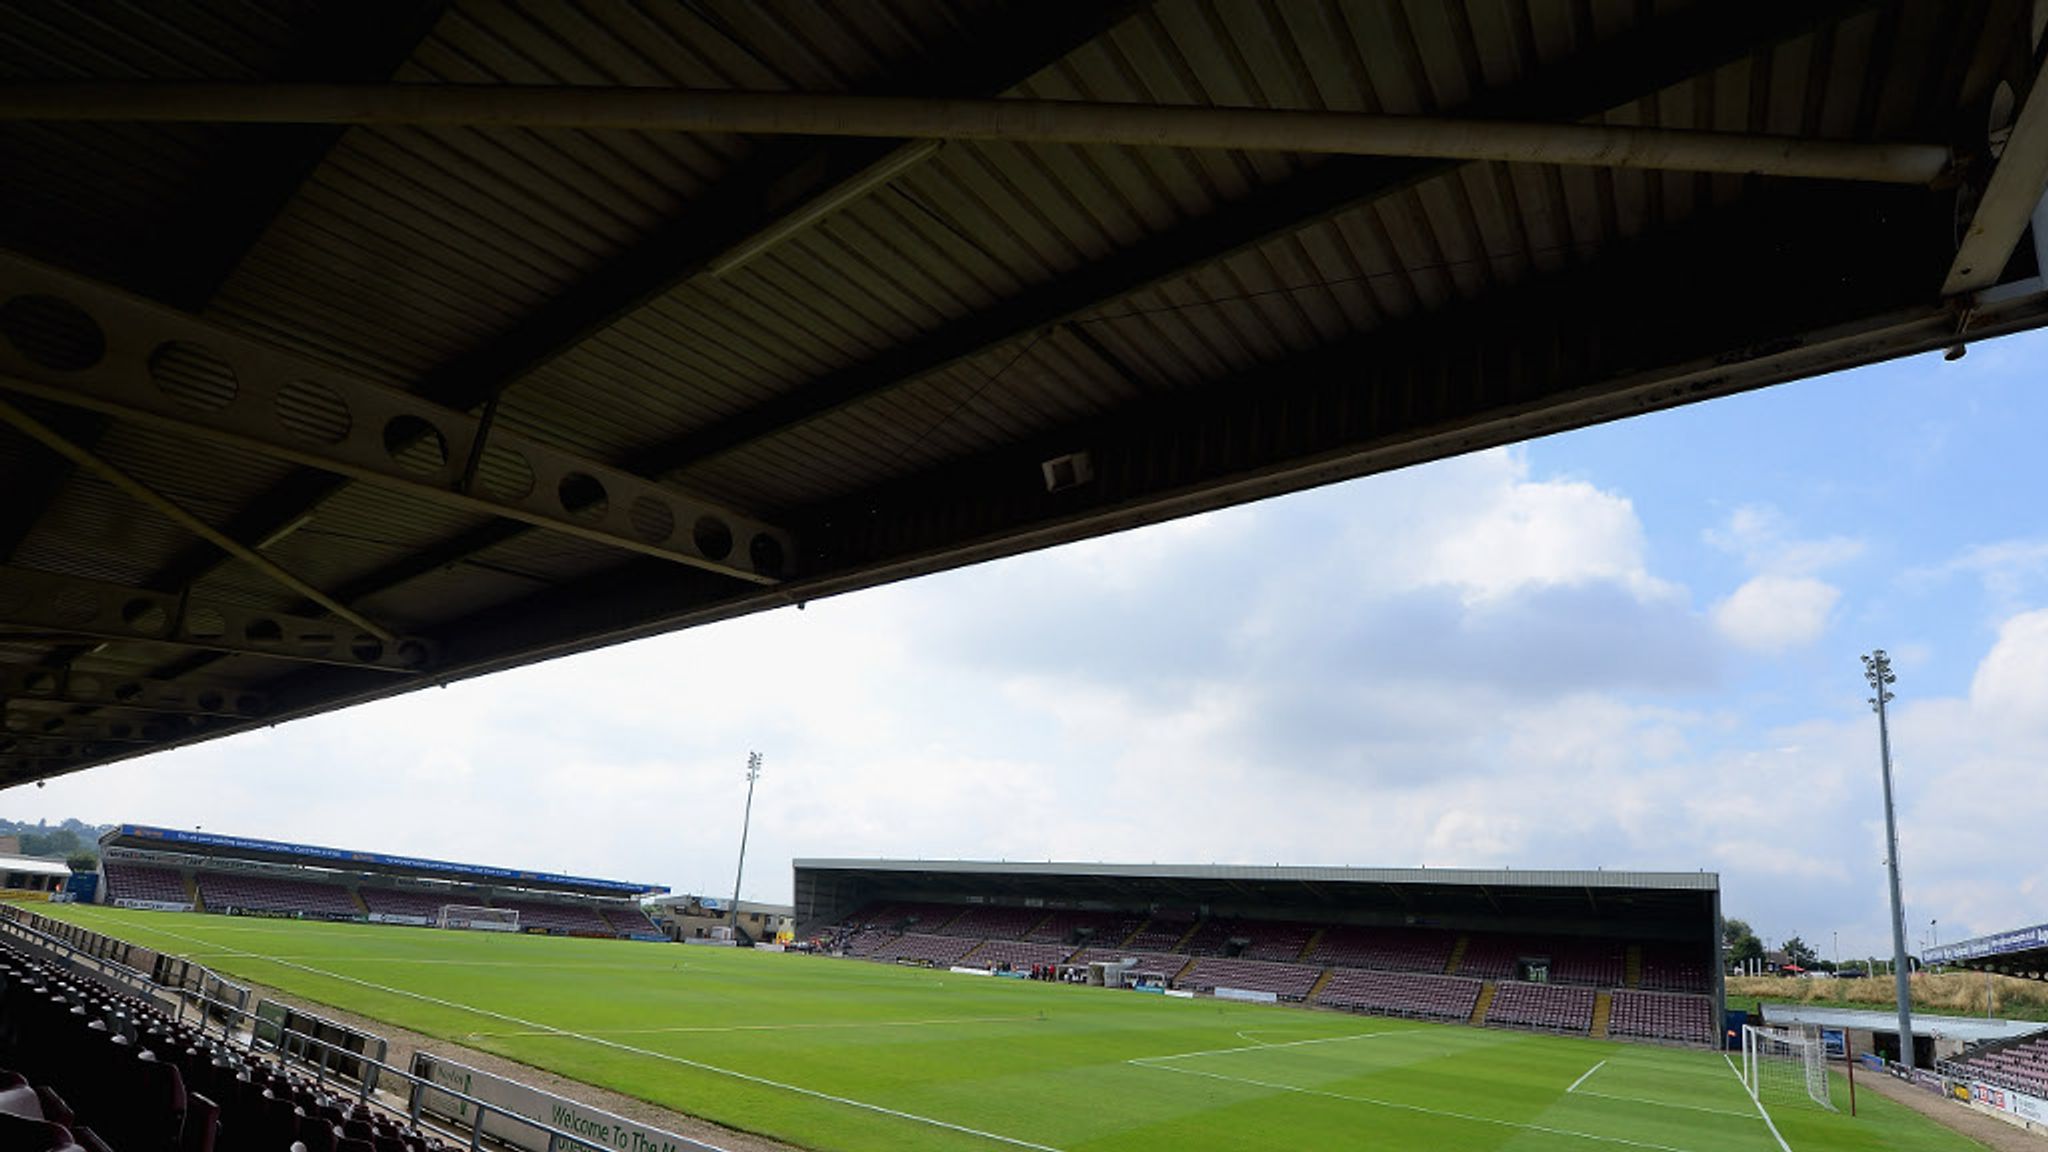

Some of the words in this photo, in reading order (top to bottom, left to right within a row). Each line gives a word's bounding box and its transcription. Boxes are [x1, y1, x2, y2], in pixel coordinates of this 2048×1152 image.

[552, 1103, 609, 1142] Welcome
[613, 1126, 628, 1149] To
[632, 1132, 657, 1152] The
